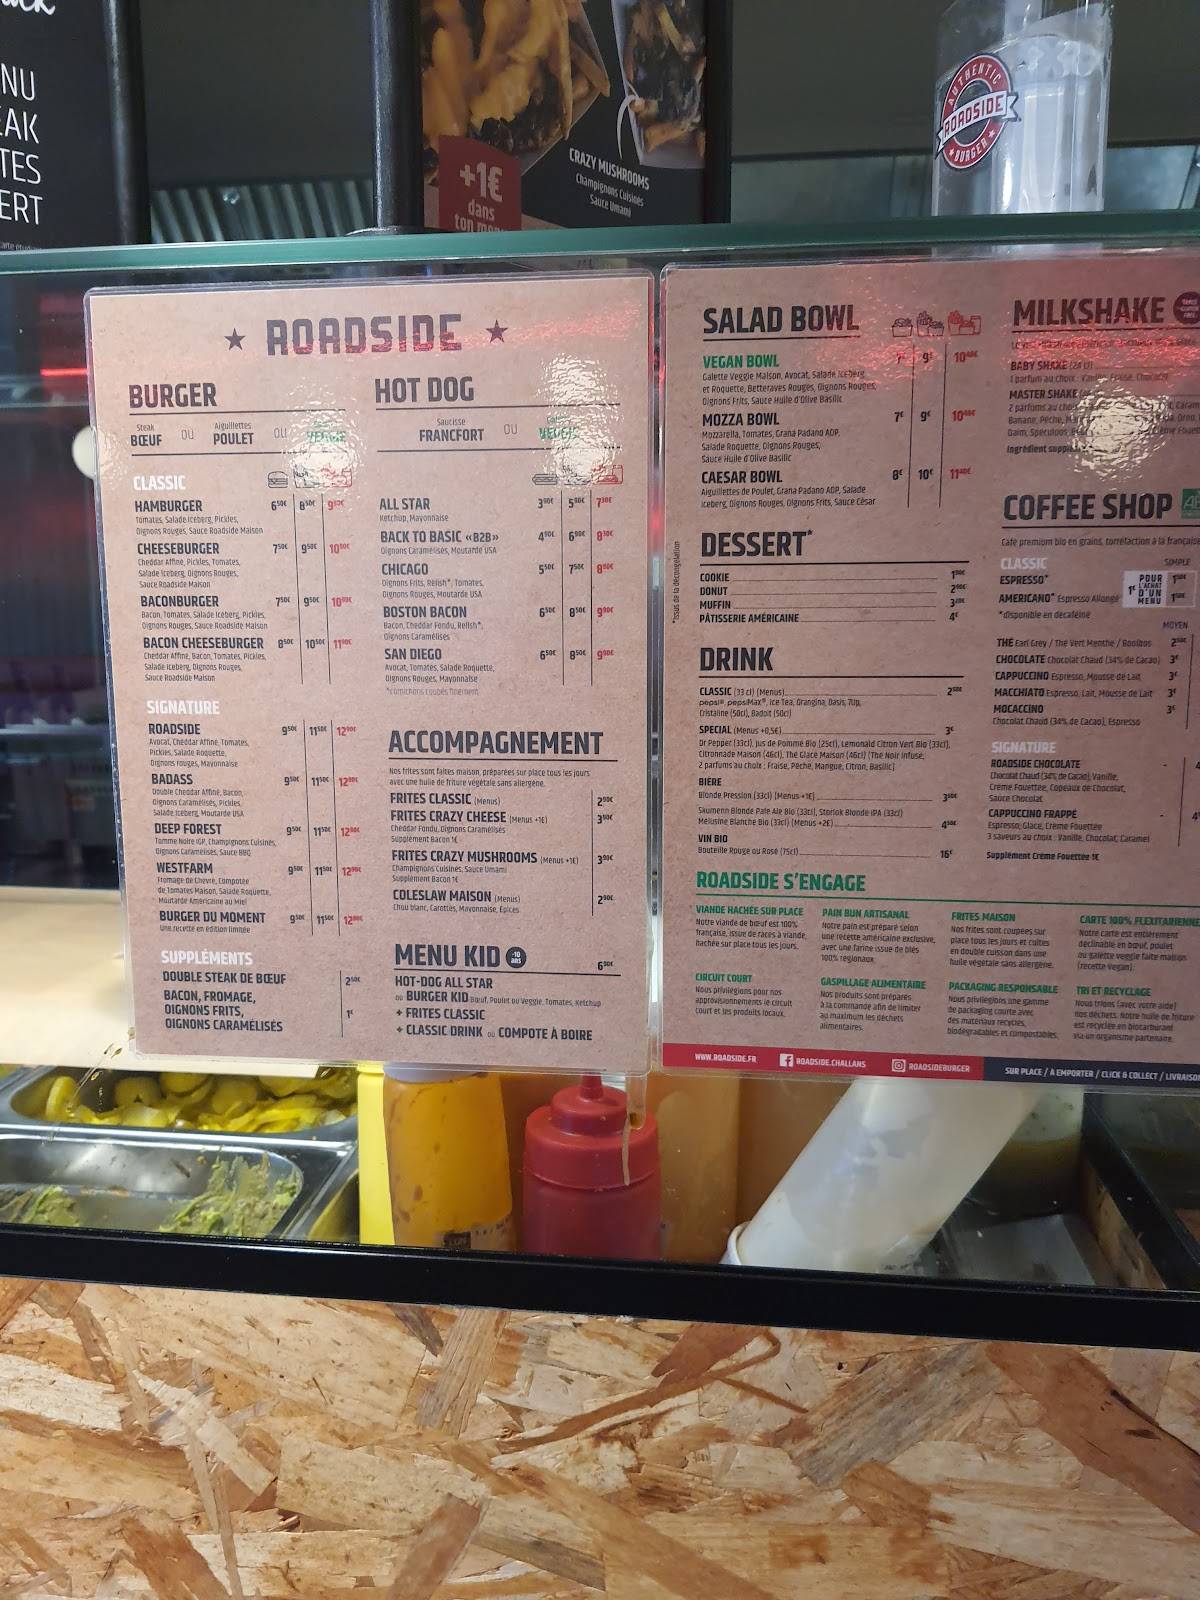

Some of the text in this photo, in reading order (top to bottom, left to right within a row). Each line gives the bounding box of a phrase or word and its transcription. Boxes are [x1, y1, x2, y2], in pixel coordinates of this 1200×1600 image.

[947, 63, 1001, 106] AUTHENTIC
[943, 95, 1004, 138] ROADSIDE
[954, 138, 988, 162] BURGER
[569, 147, 650, 190] CRAZY MUSHROOMS
[459, 162, 503, 202] +1€
[576, 173, 618, 198] Champignons
[468, 199, 495, 221] dans
[590, 194, 632, 218] Sauce Umami
[454, 214, 475, 233] ton
[1013, 296, 1166, 327] MILKSHAKE
[703, 304, 860, 334] SALAD BOWL
[266, 313, 462, 356] ROADSIDE
[703, 354, 779, 369] VEGAN BOWL
[1010, 361, 1067, 371] BABY SHAKE
[128, 382, 217, 409] BURGER
[374, 376, 474, 403] HOT DOG
[1009, 389, 1078, 399] MASTER SHAKE
[436, 417, 466, 426] Saucisse
[702, 413, 744, 427] MOZZA
[747, 412, 780, 426] BOWL
[419, 423, 518, 442] FRANCFORT OU
[130, 432, 254, 447] BŒUF POULET
[133, 475, 186, 490] CLASSIC
[701, 470, 783, 484] CAESAR BOWL
[135, 500, 203, 513] HAMBURGER
[380, 498, 430, 510] ALL STAR
[1003, 493, 1173, 521] COFFEE SHOP
[409, 514, 449, 523] Mayonnaise
[380, 531, 410, 543] BACK
[412, 531, 427, 542] TO
[429, 531, 462, 542] BASIC
[137, 542, 220, 555] CHEESEBURGER
[382, 563, 429, 576] CHICAGO
[1000, 557, 1048, 570] CLASSIC
[699, 573, 730, 582] COOKIE
[699, 587, 728, 596] DONUT
[141, 595, 219, 607] BACONBURGER
[699, 600, 731, 610] MUFFIN
[383, 606, 467, 618] BOSTON BACON
[699, 613, 800, 623] PÂTISSERIE AMÉRICAINE
[1163, 621, 1188, 630] MOYEN
[143, 637, 264, 649] BACON CHEESEBURGER
[384, 648, 442, 660] SAN DIEGO
[699, 647, 774, 672] DRINK
[996, 655, 1045, 664] CHOCOLATE
[409, 664, 438, 673] Tomates,
[439, 664, 461, 673] Salade
[995, 671, 1049, 681] CAPPUCCINO
[699, 687, 732, 697] CLASSIC
[994, 688, 1045, 698] MACCHIATO
[147, 700, 220, 715] SIGNATURE
[993, 704, 1044, 714] MOCACCINO
[148, 723, 201, 735] ROADSIDE
[699, 725, 732, 735] SPECIAL
[388, 730, 604, 755] ACCOMPAGNEMENT
[991, 741, 1057, 754] SIGNATURE
[991, 759, 1081, 769] ROADSIDE CHOCOLATE
[151, 773, 193, 785] BADASS
[390, 793, 471, 805] FRITES CLASSIC
[390, 811, 507, 823] FRITES CRAZY CHEESE
[988, 809, 1042, 819] CAPPUCCINO
[154, 823, 222, 835] DEEP FOREST
[391, 850, 538, 863] FRITES CRAZY MUSHROOMS
[156, 862, 213, 874] WESTFARM
[696, 871, 779, 890] ROADSIDE
[393, 889, 492, 902] COLESLAW MAISON
[696, 904, 804, 916] VIANDE PLACE
[822, 908, 910, 919] PAIN ARTISANAL
[159, 911, 266, 923] BURGER DU MOMENT
[951, 911, 1016, 922] FRITES MAISON
[161, 949, 253, 966] SUPPLÉMENTS
[395, 943, 500, 968] MENU KID
[163, 971, 287, 985] DOUBLE STEAK DE BŒUF
[395, 976, 493, 989] HOT-DOG ALL STAR
[695, 973, 753, 983] CIRCUIT COURT
[820, 977, 927, 990] GASPILLAGE ALIMENTAIRE
[949, 982, 1059, 994] PACKAGING RESPONSABLE
[1103, 987, 1151, 997] RECYCLAGE
[164, 989, 256, 1004] BACON, FROMAGE,
[406, 991, 469, 1003] BURGER KID
[164, 1004, 244, 1018] OIGNONS FRITS,
[405, 1008, 486, 1020] FRITES CLASSIC
[165, 1018, 283, 1032] OIGNONS CARAMÉLISÉS
[406, 1025, 592, 1041] CLASSIC DRINK COMPOTE BOIRE
[695, 1052, 757, 1063] WWW.ROADSIDE.FR
[796, 1057, 867, 1068] ROADSIDE.CHALLANS
[908, 1062, 971, 1073] ROADSIDEBURGER
[1005, 1066, 1157, 1081] SUR PLACE EMPORTER COLLECT
